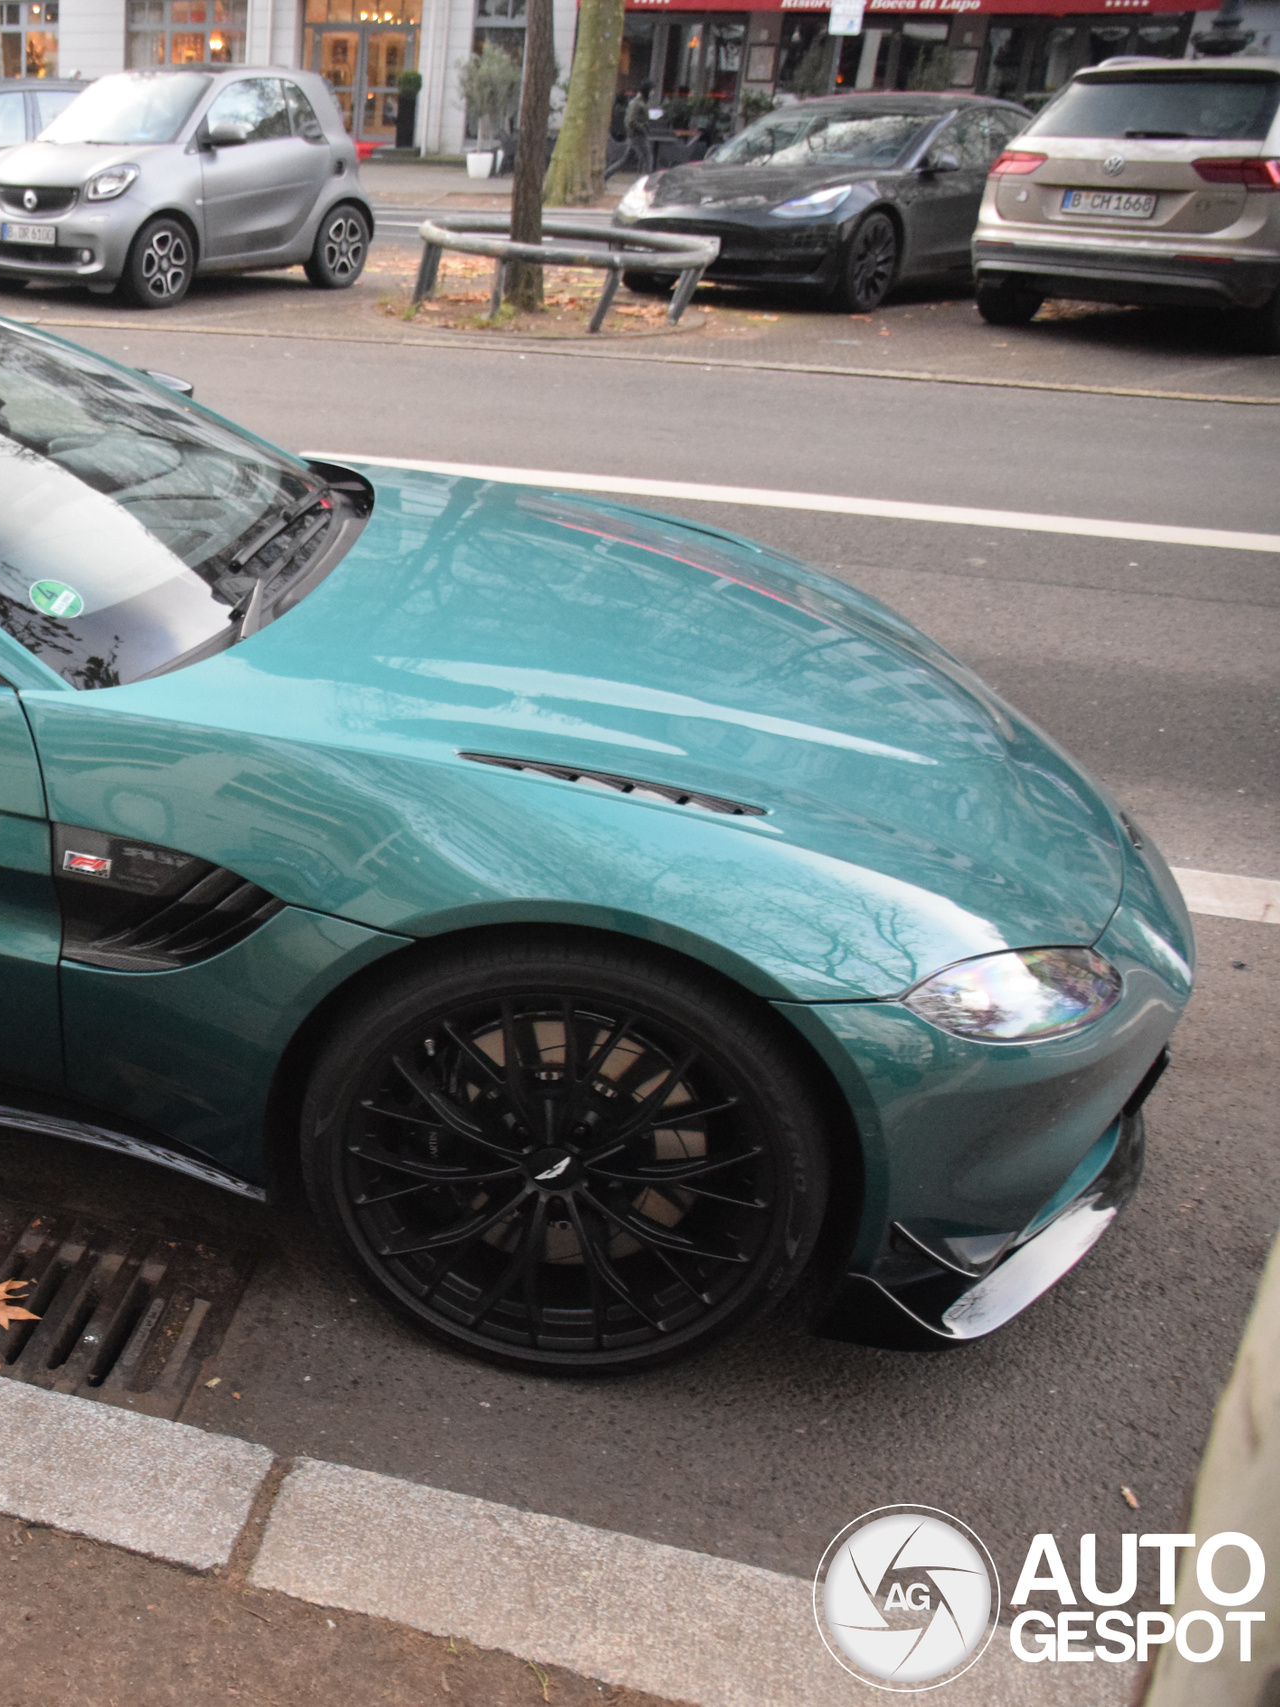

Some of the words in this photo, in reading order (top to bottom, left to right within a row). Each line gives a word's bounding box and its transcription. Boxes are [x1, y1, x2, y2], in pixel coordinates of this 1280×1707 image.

[1071, 193, 1082, 208] B
[1090, 194, 1113, 210] CH
[1113, 195, 1153, 212] 1668
